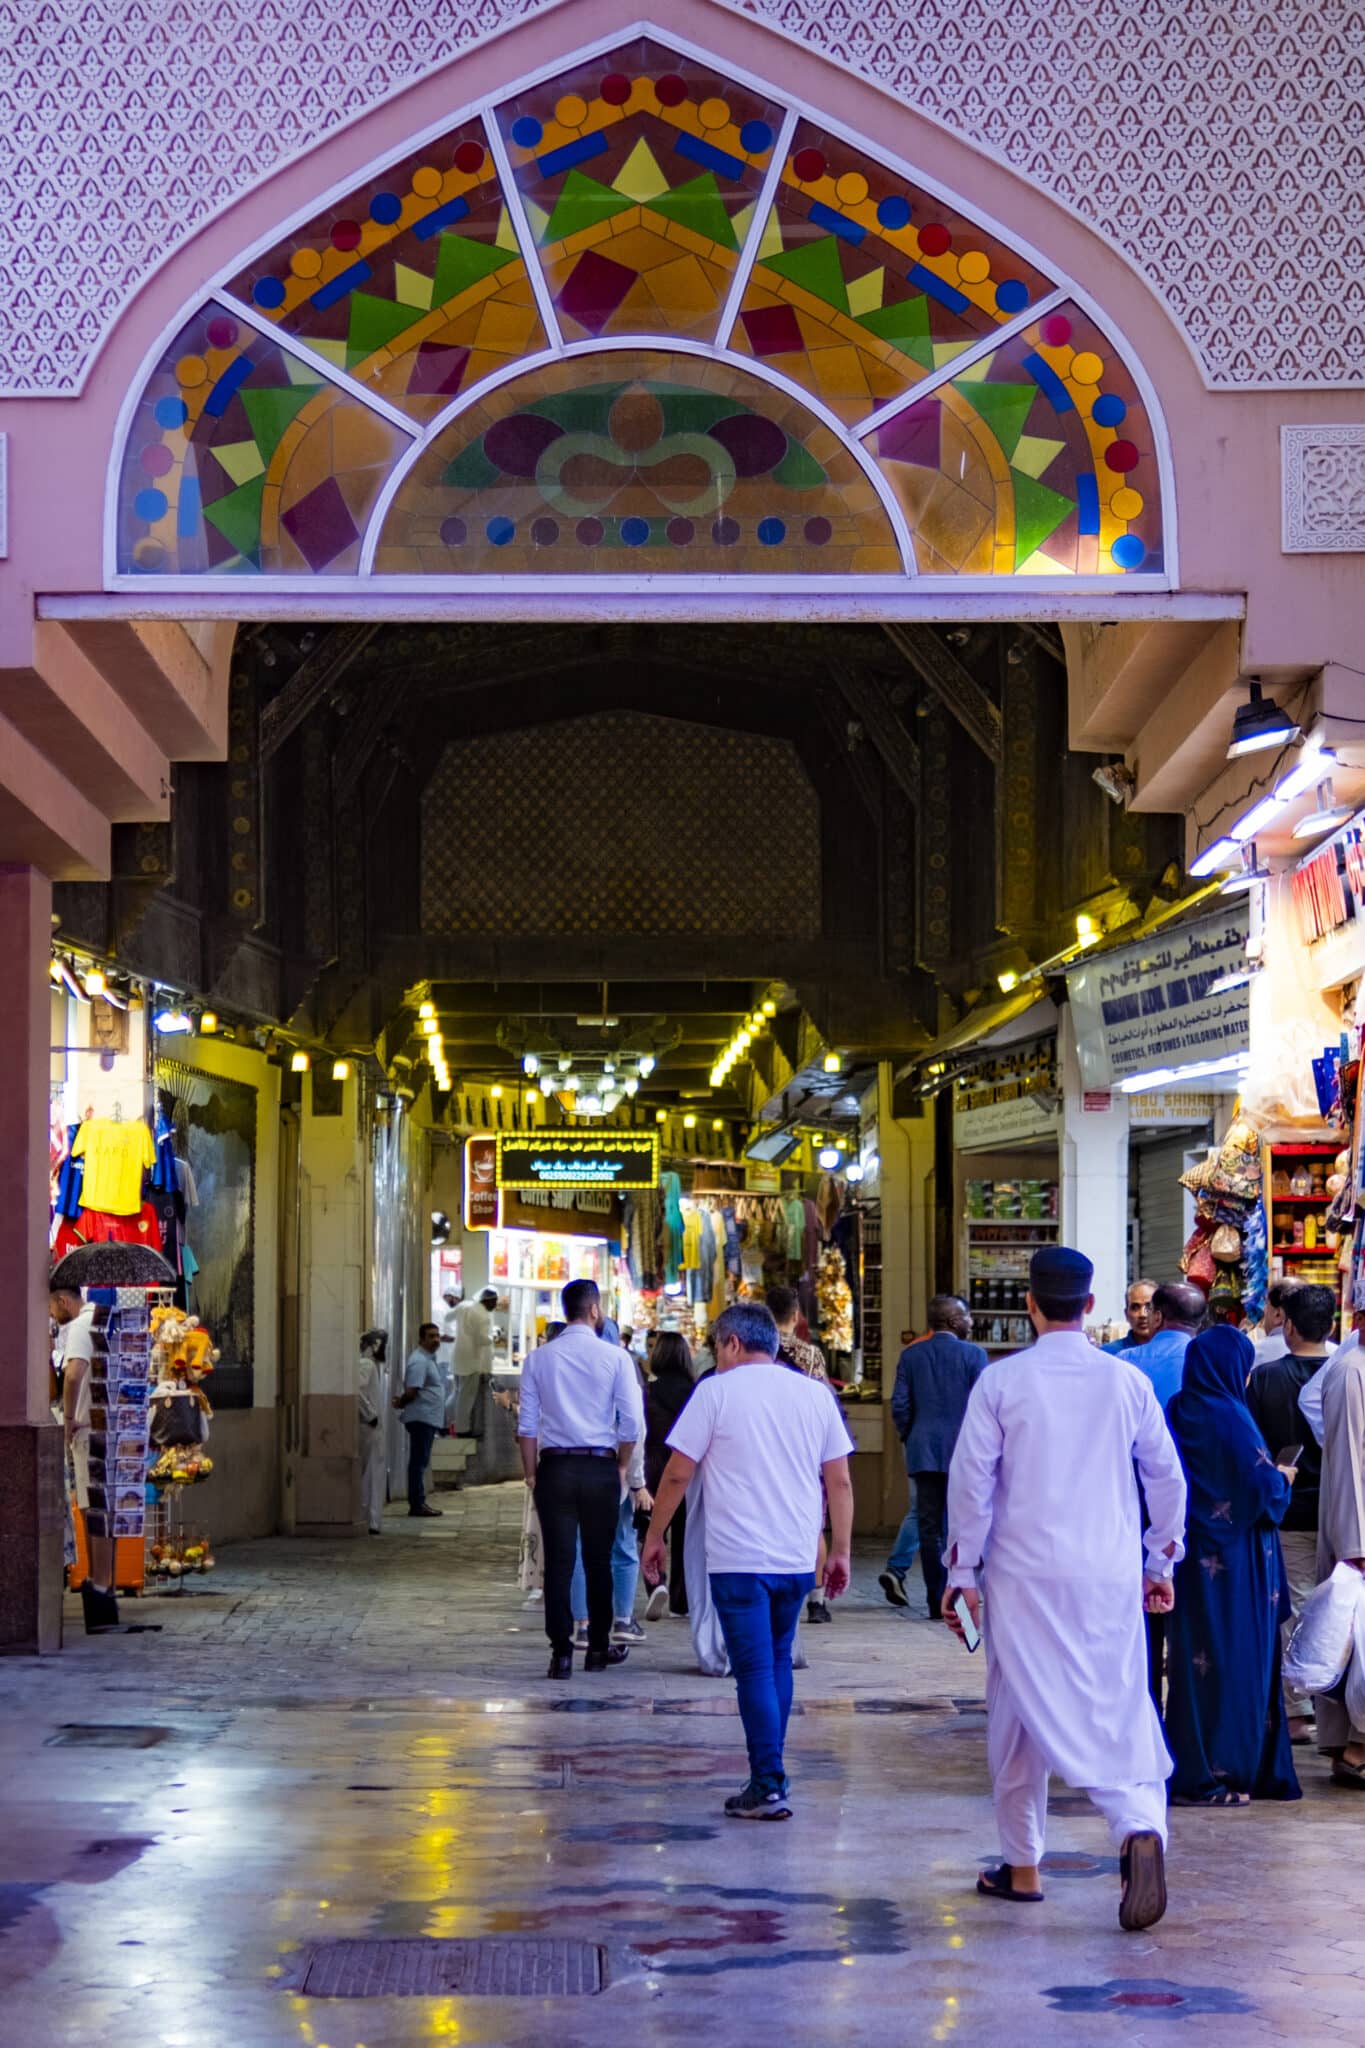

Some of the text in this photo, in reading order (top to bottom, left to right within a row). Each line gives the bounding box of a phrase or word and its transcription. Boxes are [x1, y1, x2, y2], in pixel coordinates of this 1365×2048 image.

[1212, 998, 1249, 1021] تحضرات
[1186, 1026, 1224, 1047] TAILORING
[1223, 1019, 1249, 1038] MATER
